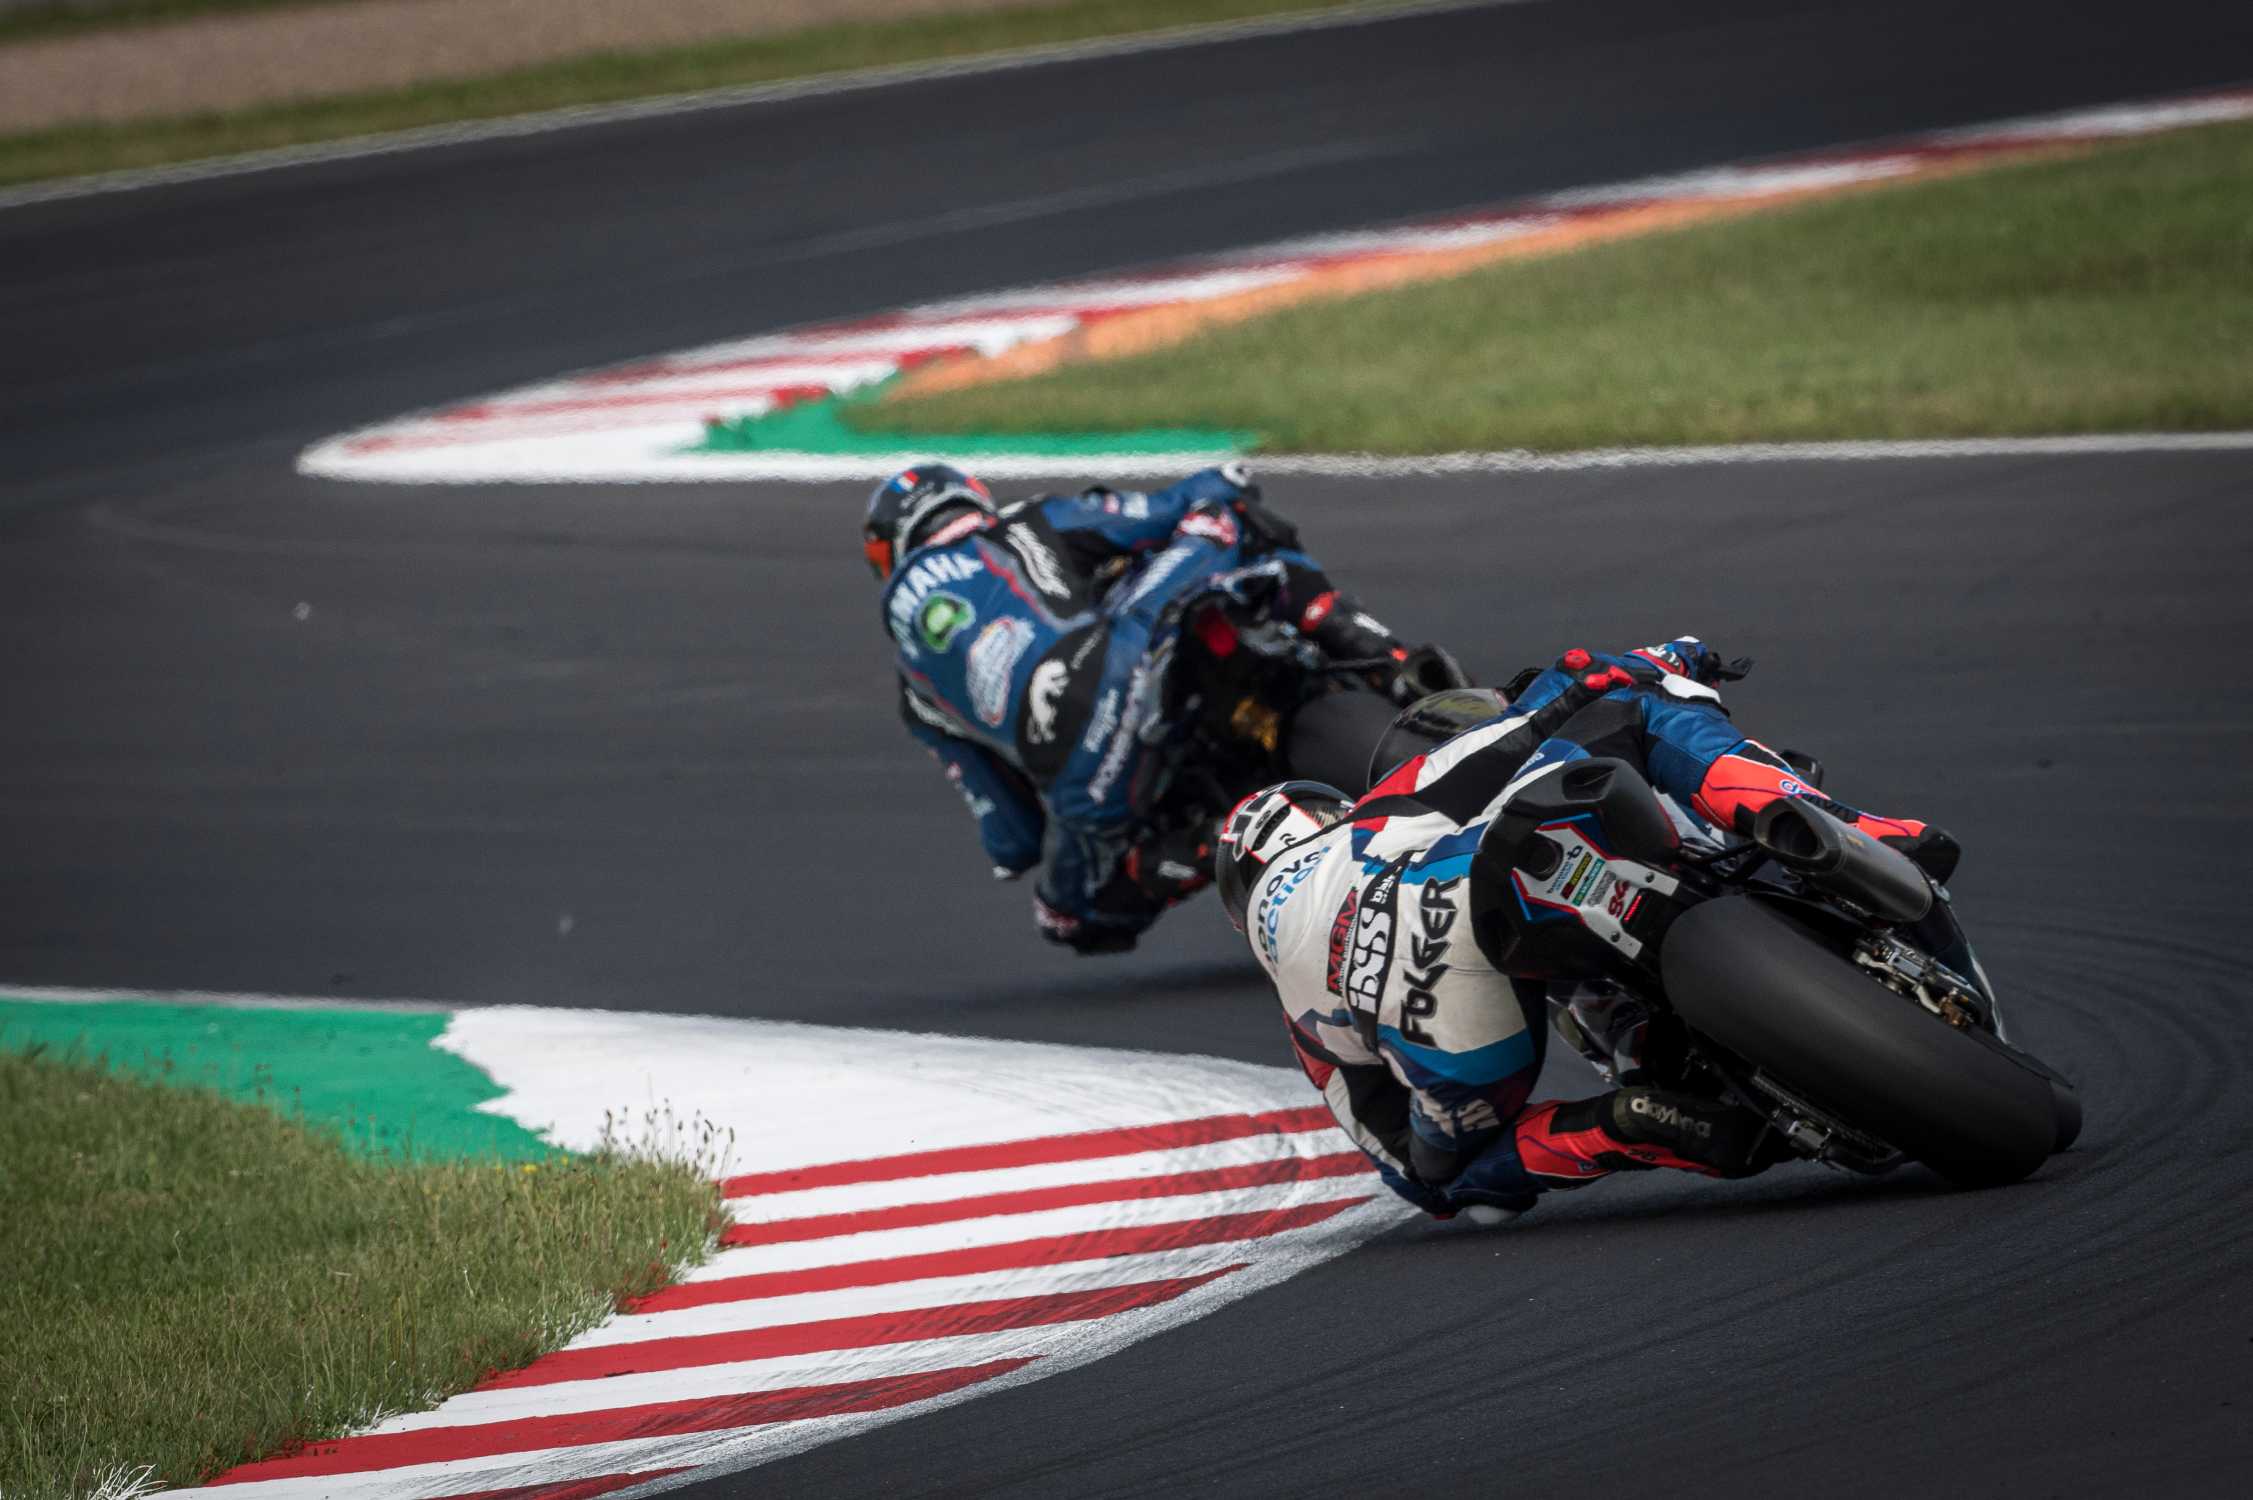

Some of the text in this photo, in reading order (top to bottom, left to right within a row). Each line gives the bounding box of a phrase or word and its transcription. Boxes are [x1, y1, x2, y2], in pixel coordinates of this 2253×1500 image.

[1257, 851, 1322, 962] onovo
[1267, 846, 1331, 967] actio
[1327, 888, 1359, 992] MGM
[1400, 876, 1464, 1048] FOLGER
[1631, 1096, 1712, 1138] daytna
